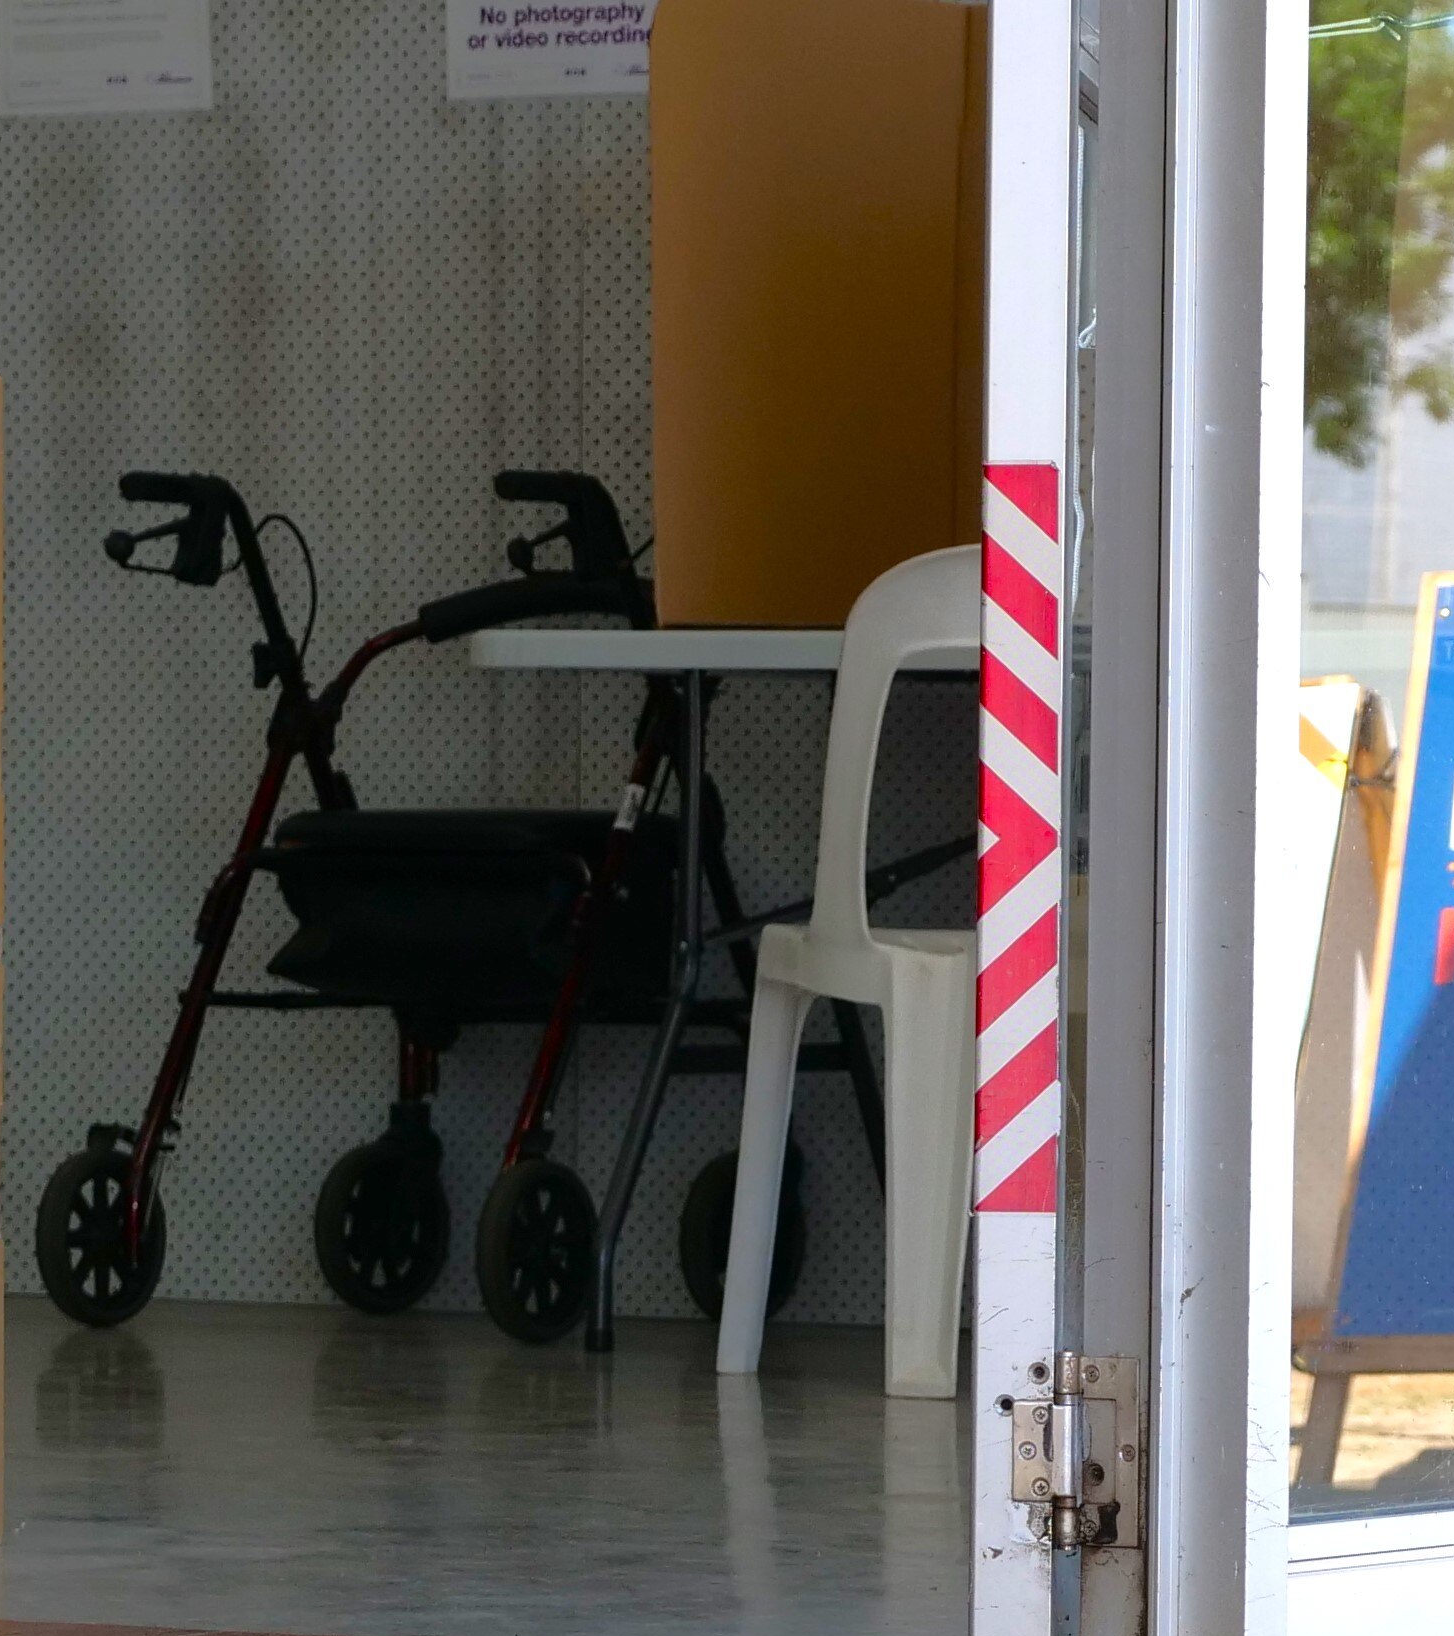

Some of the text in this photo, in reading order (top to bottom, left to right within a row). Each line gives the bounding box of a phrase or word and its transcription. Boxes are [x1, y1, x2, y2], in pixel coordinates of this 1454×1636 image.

[479, 2, 646, 27] No photography
[467, 33, 488, 49] or
[495, 28, 550, 48] video
